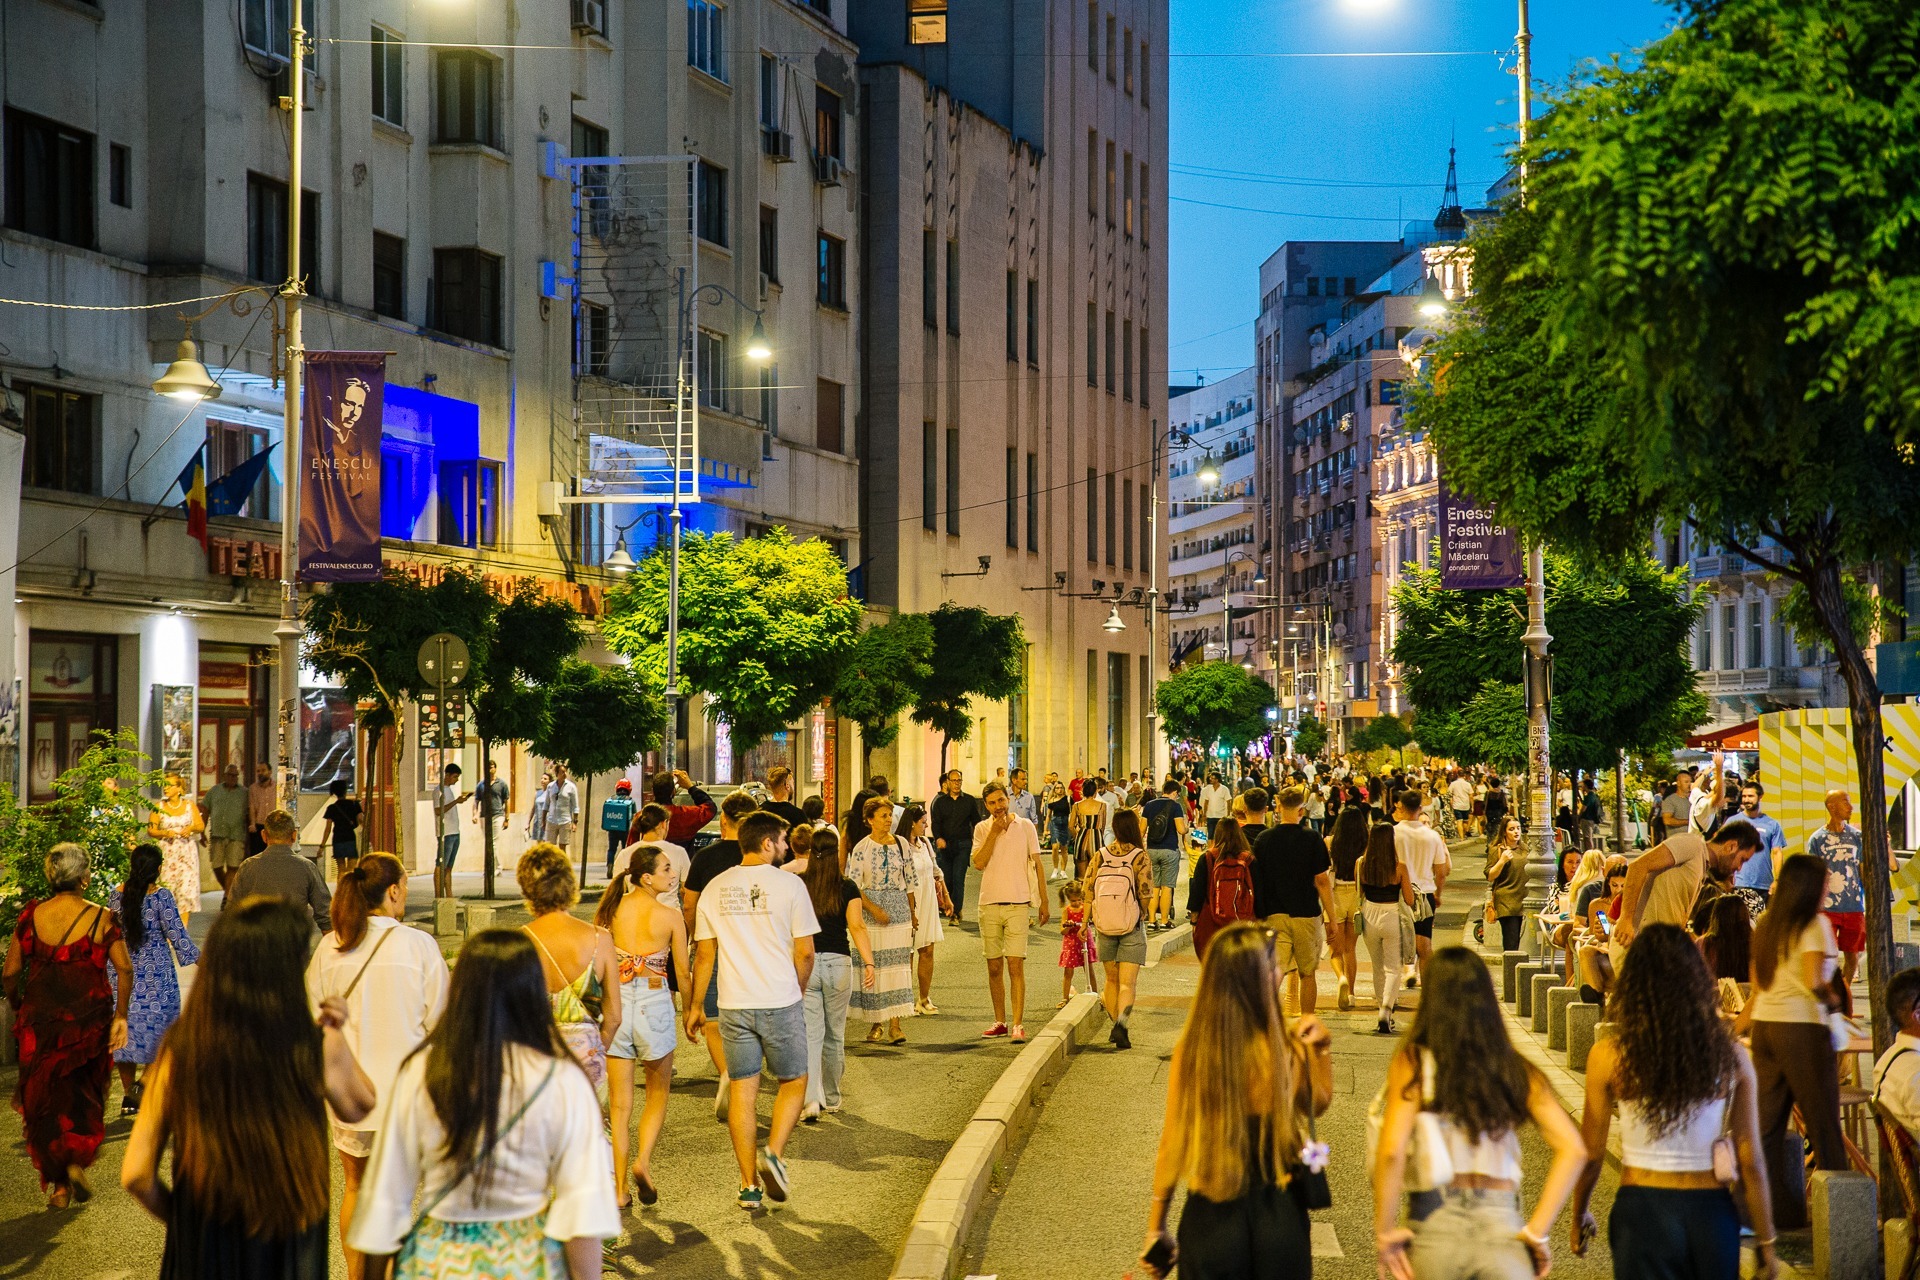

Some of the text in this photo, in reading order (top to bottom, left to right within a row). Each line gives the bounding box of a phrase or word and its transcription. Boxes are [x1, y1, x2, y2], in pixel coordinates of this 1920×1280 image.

[312, 458, 372, 469] ENESCU
[311, 472, 371, 480] FESTIVAL
[1447, 507, 1496, 520] Enesc
[1448, 523, 1507, 537] Festival
[1448, 541, 1482, 550] Cristian
[1448, 552, 1489, 561] Măcelaru
[309, 562, 374, 570] FESTIVALENESCU.RO
[1533, 726, 1546, 735] BNE
[606, 812, 624, 820] Wolt
